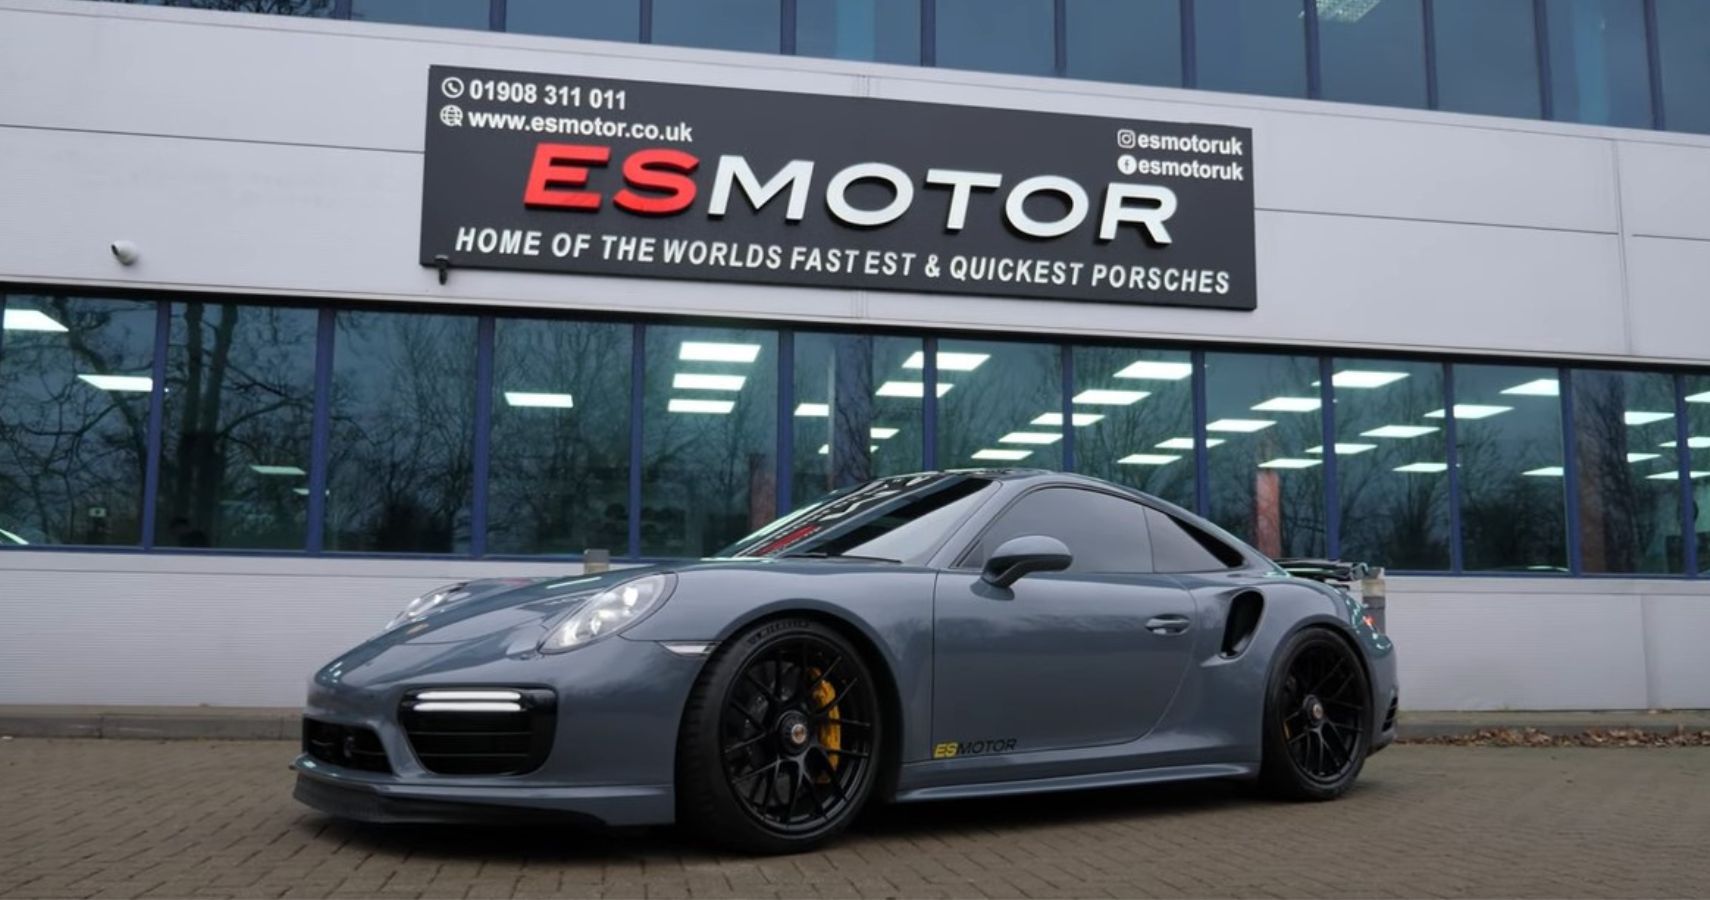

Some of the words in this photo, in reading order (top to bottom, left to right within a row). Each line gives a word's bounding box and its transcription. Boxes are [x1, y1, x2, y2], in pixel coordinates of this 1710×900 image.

[469, 79, 537, 104] 01908
[544, 84, 581, 107] 311
[589, 88, 626, 110] 011
[468, 110, 693, 142] www.esmotor.co.uk
[1137, 132, 1243, 156] esmotoruk
[1138, 157, 1244, 181] esmotoruk
[524, 142, 1178, 245] ESMOTOR
[455, 226, 542, 256] HOME
[551, 232, 591, 258] OF
[601, 235, 656, 262] THE
[663, 239, 783, 269] WORLDS
[924, 254, 941, 277] &
[949, 255, 1084, 286] QUICKEST
[1091, 263, 1230, 294] PORSCHES
[933, 738, 1017, 759] ESMOTOR
